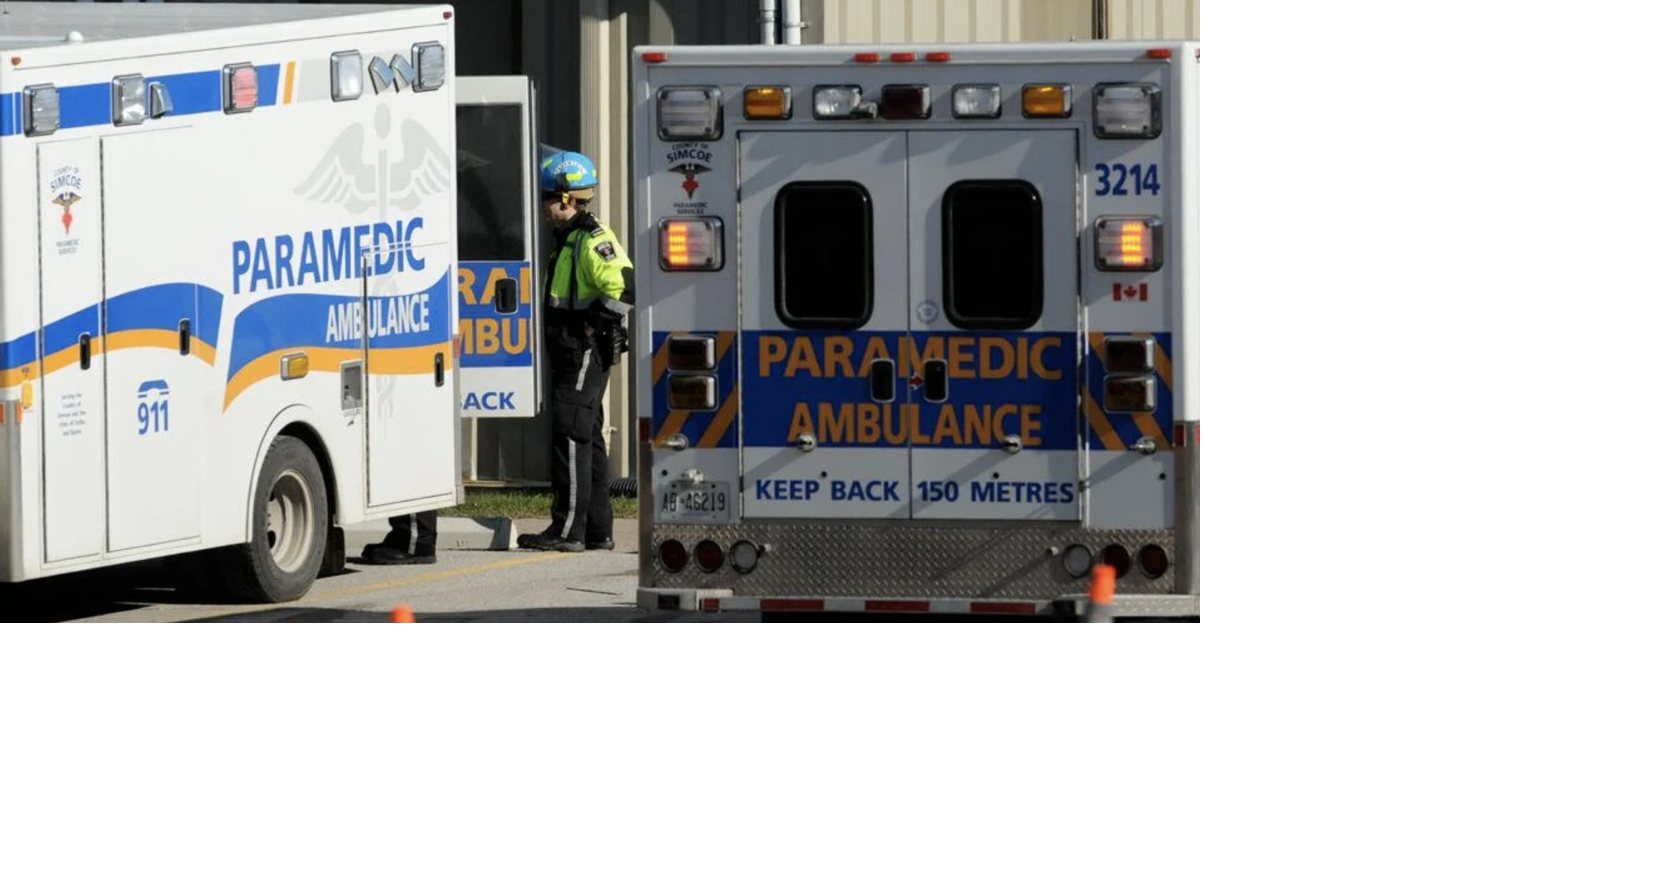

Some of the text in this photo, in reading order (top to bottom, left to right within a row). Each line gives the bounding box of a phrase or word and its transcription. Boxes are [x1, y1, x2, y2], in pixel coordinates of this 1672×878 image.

[666, 149, 714, 164] SIMCOE
[51, 174, 82, 193] SIMCOE
[1095, 163, 1160, 196] 3214
[232, 216, 426, 295] PARAMEDIC
[326, 293, 430, 343] AMBULANCE
[758, 335, 1063, 381] PARAMEDIC
[137, 399, 169, 436] 911
[460, 391, 516, 411] ACK
[787, 402, 1042, 446] AMBULANCE
[756, 479, 1075, 504] KEEP BACK 150 METRES
